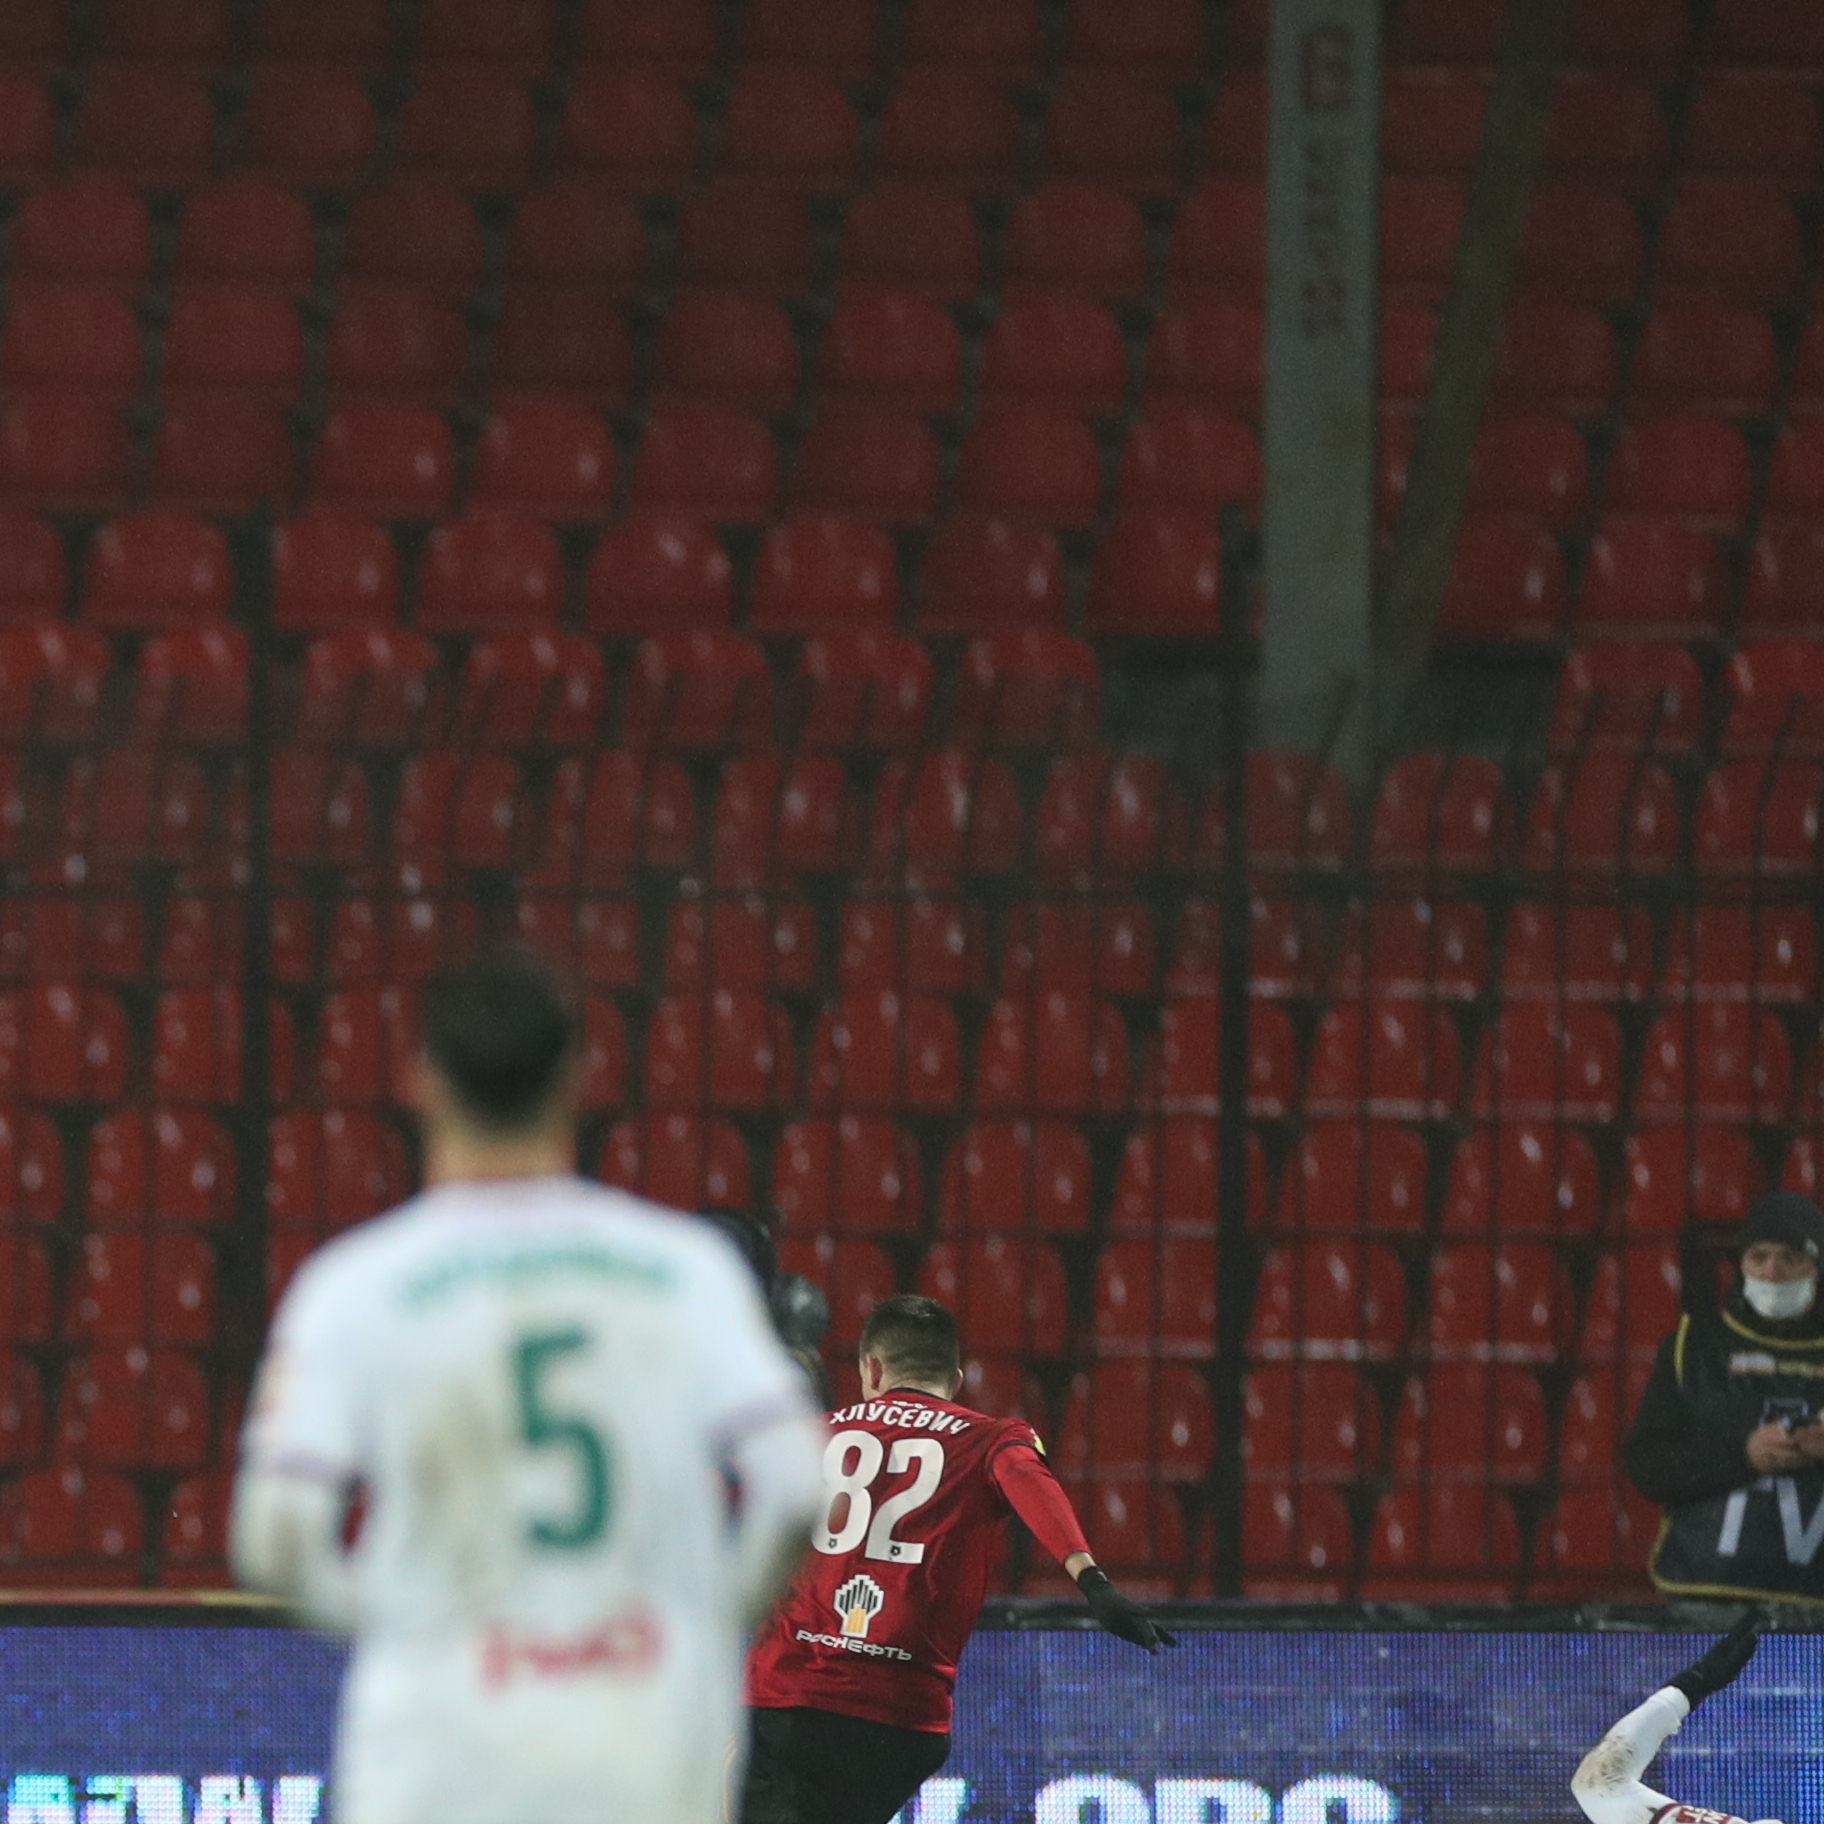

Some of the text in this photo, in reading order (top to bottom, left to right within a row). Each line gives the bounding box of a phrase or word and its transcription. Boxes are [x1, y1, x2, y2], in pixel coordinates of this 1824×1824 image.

[509, 1325, 611, 1549] 5
[830, 1403, 970, 1434] ХЛУСЕВИЧ
[811, 1430, 945, 1564] 82
[796, 1630, 912, 1661] РОСНЕФТЬ
